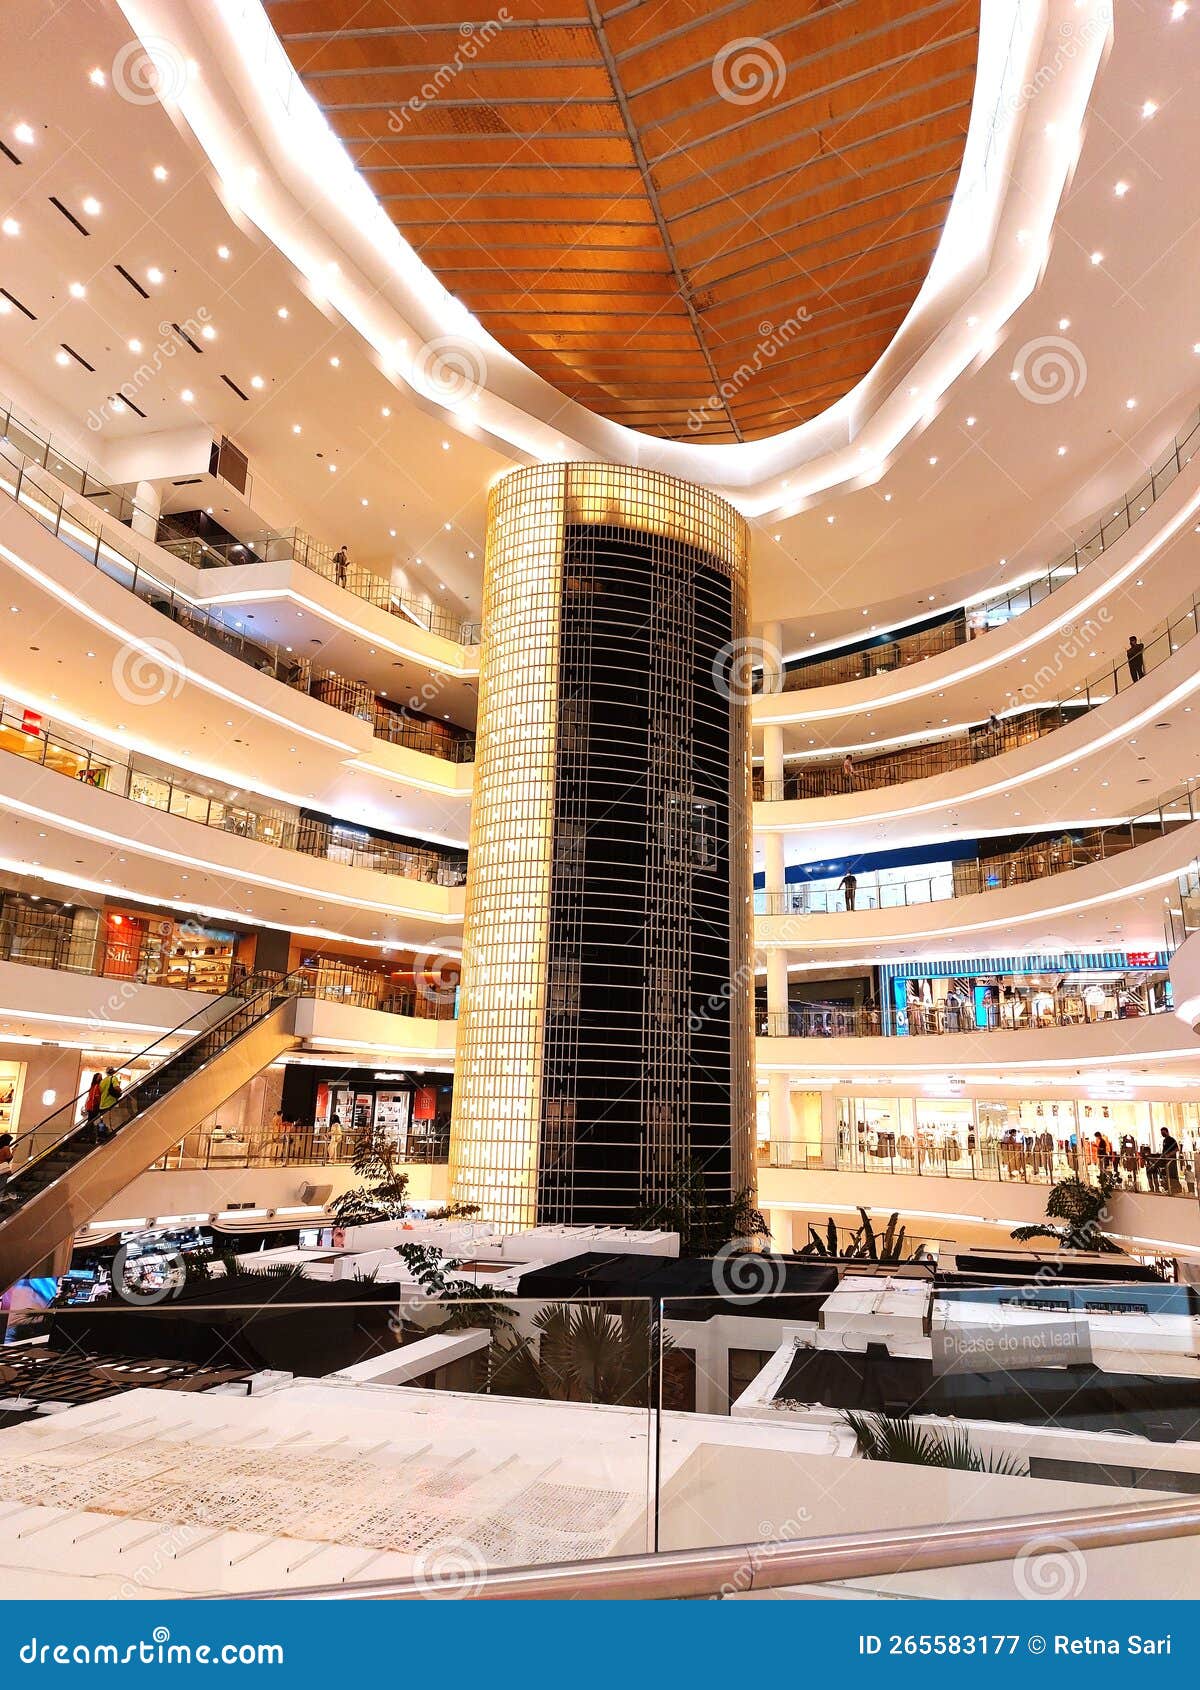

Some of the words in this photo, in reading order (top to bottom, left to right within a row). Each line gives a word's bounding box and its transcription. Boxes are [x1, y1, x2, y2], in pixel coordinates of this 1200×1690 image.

[943, 1335, 994, 1354] Please
[998, 1333, 1018, 1350] do
[1022, 1332, 1046, 1349] not
[1050, 1330, 1080, 1346] lean
